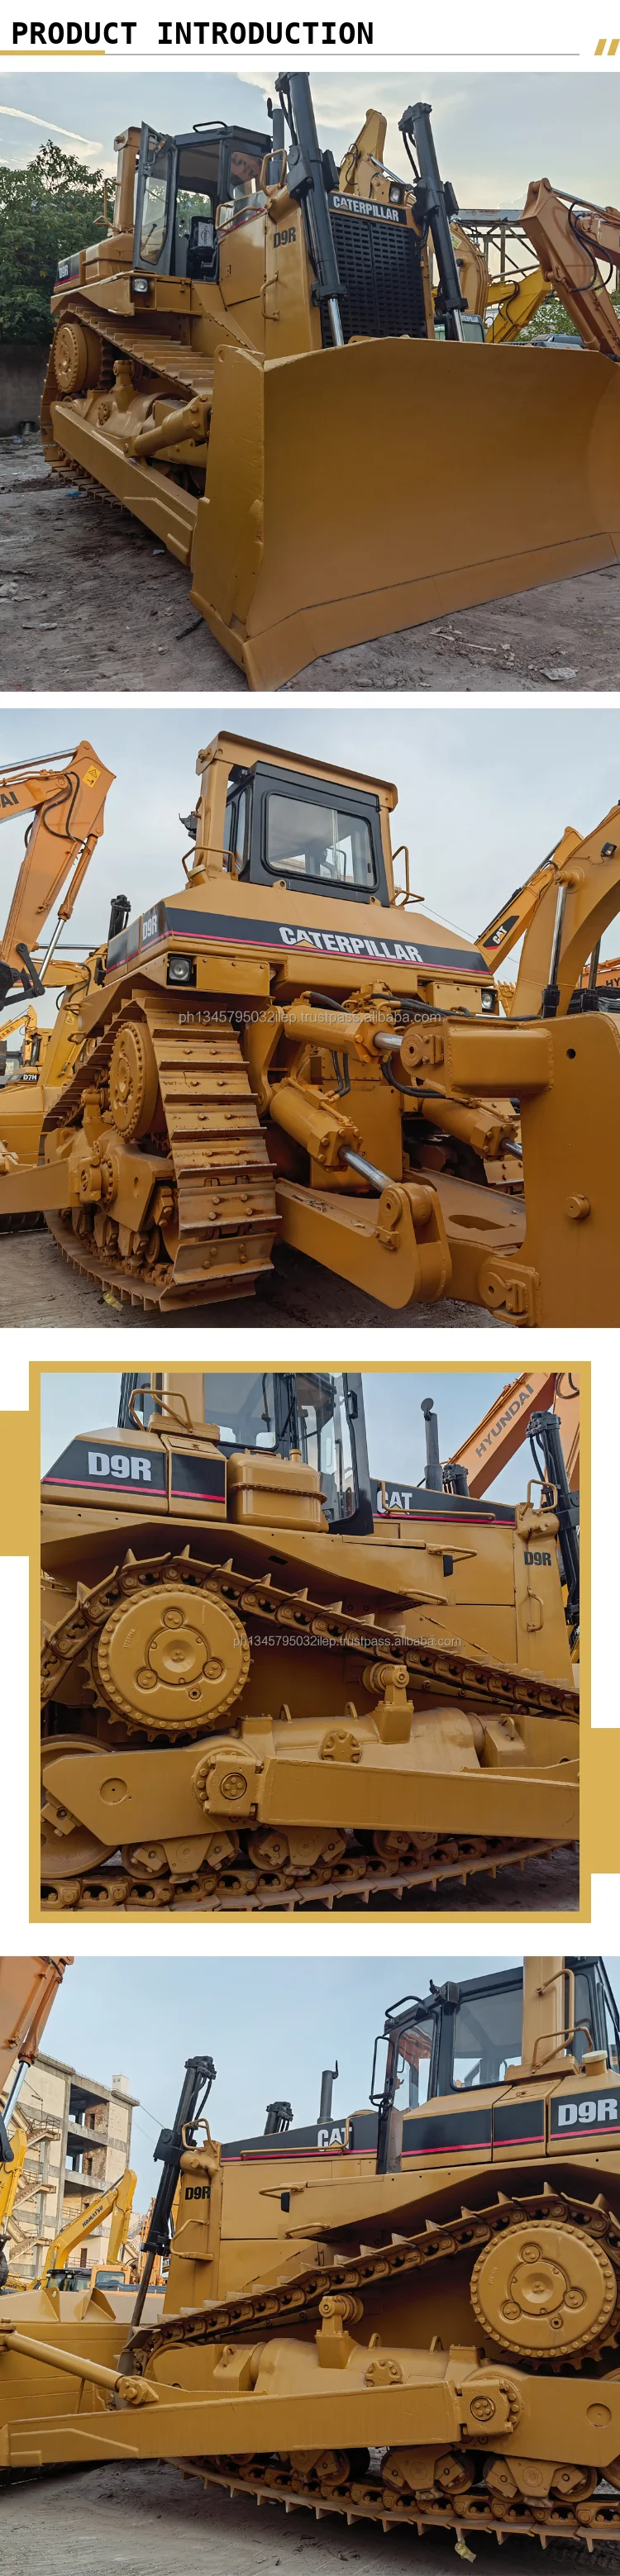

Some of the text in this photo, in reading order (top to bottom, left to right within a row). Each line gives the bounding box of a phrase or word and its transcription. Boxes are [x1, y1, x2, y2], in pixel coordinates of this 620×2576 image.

[332, 195, 399, 221] CATERPILLAR
[273, 226, 297, 248] D9R
[0, 791, 20, 808] AI
[142, 914, 157, 941] D9R
[492, 926, 508, 945] CAT
[279, 926, 424, 963] CATERPILLAR
[475, 1383, 535, 1459] HYUNDAI
[88, 1451, 152, 1482] D9R
[376, 1490, 413, 1515] CAT
[523, 1551, 552, 1567] D9R
[557, 2098, 618, 2126] D9R
[317, 2126, 353, 2152] CAT
[184, 2186, 212, 2201] D9R
[82, 2205, 103, 2228] KOMATSU
